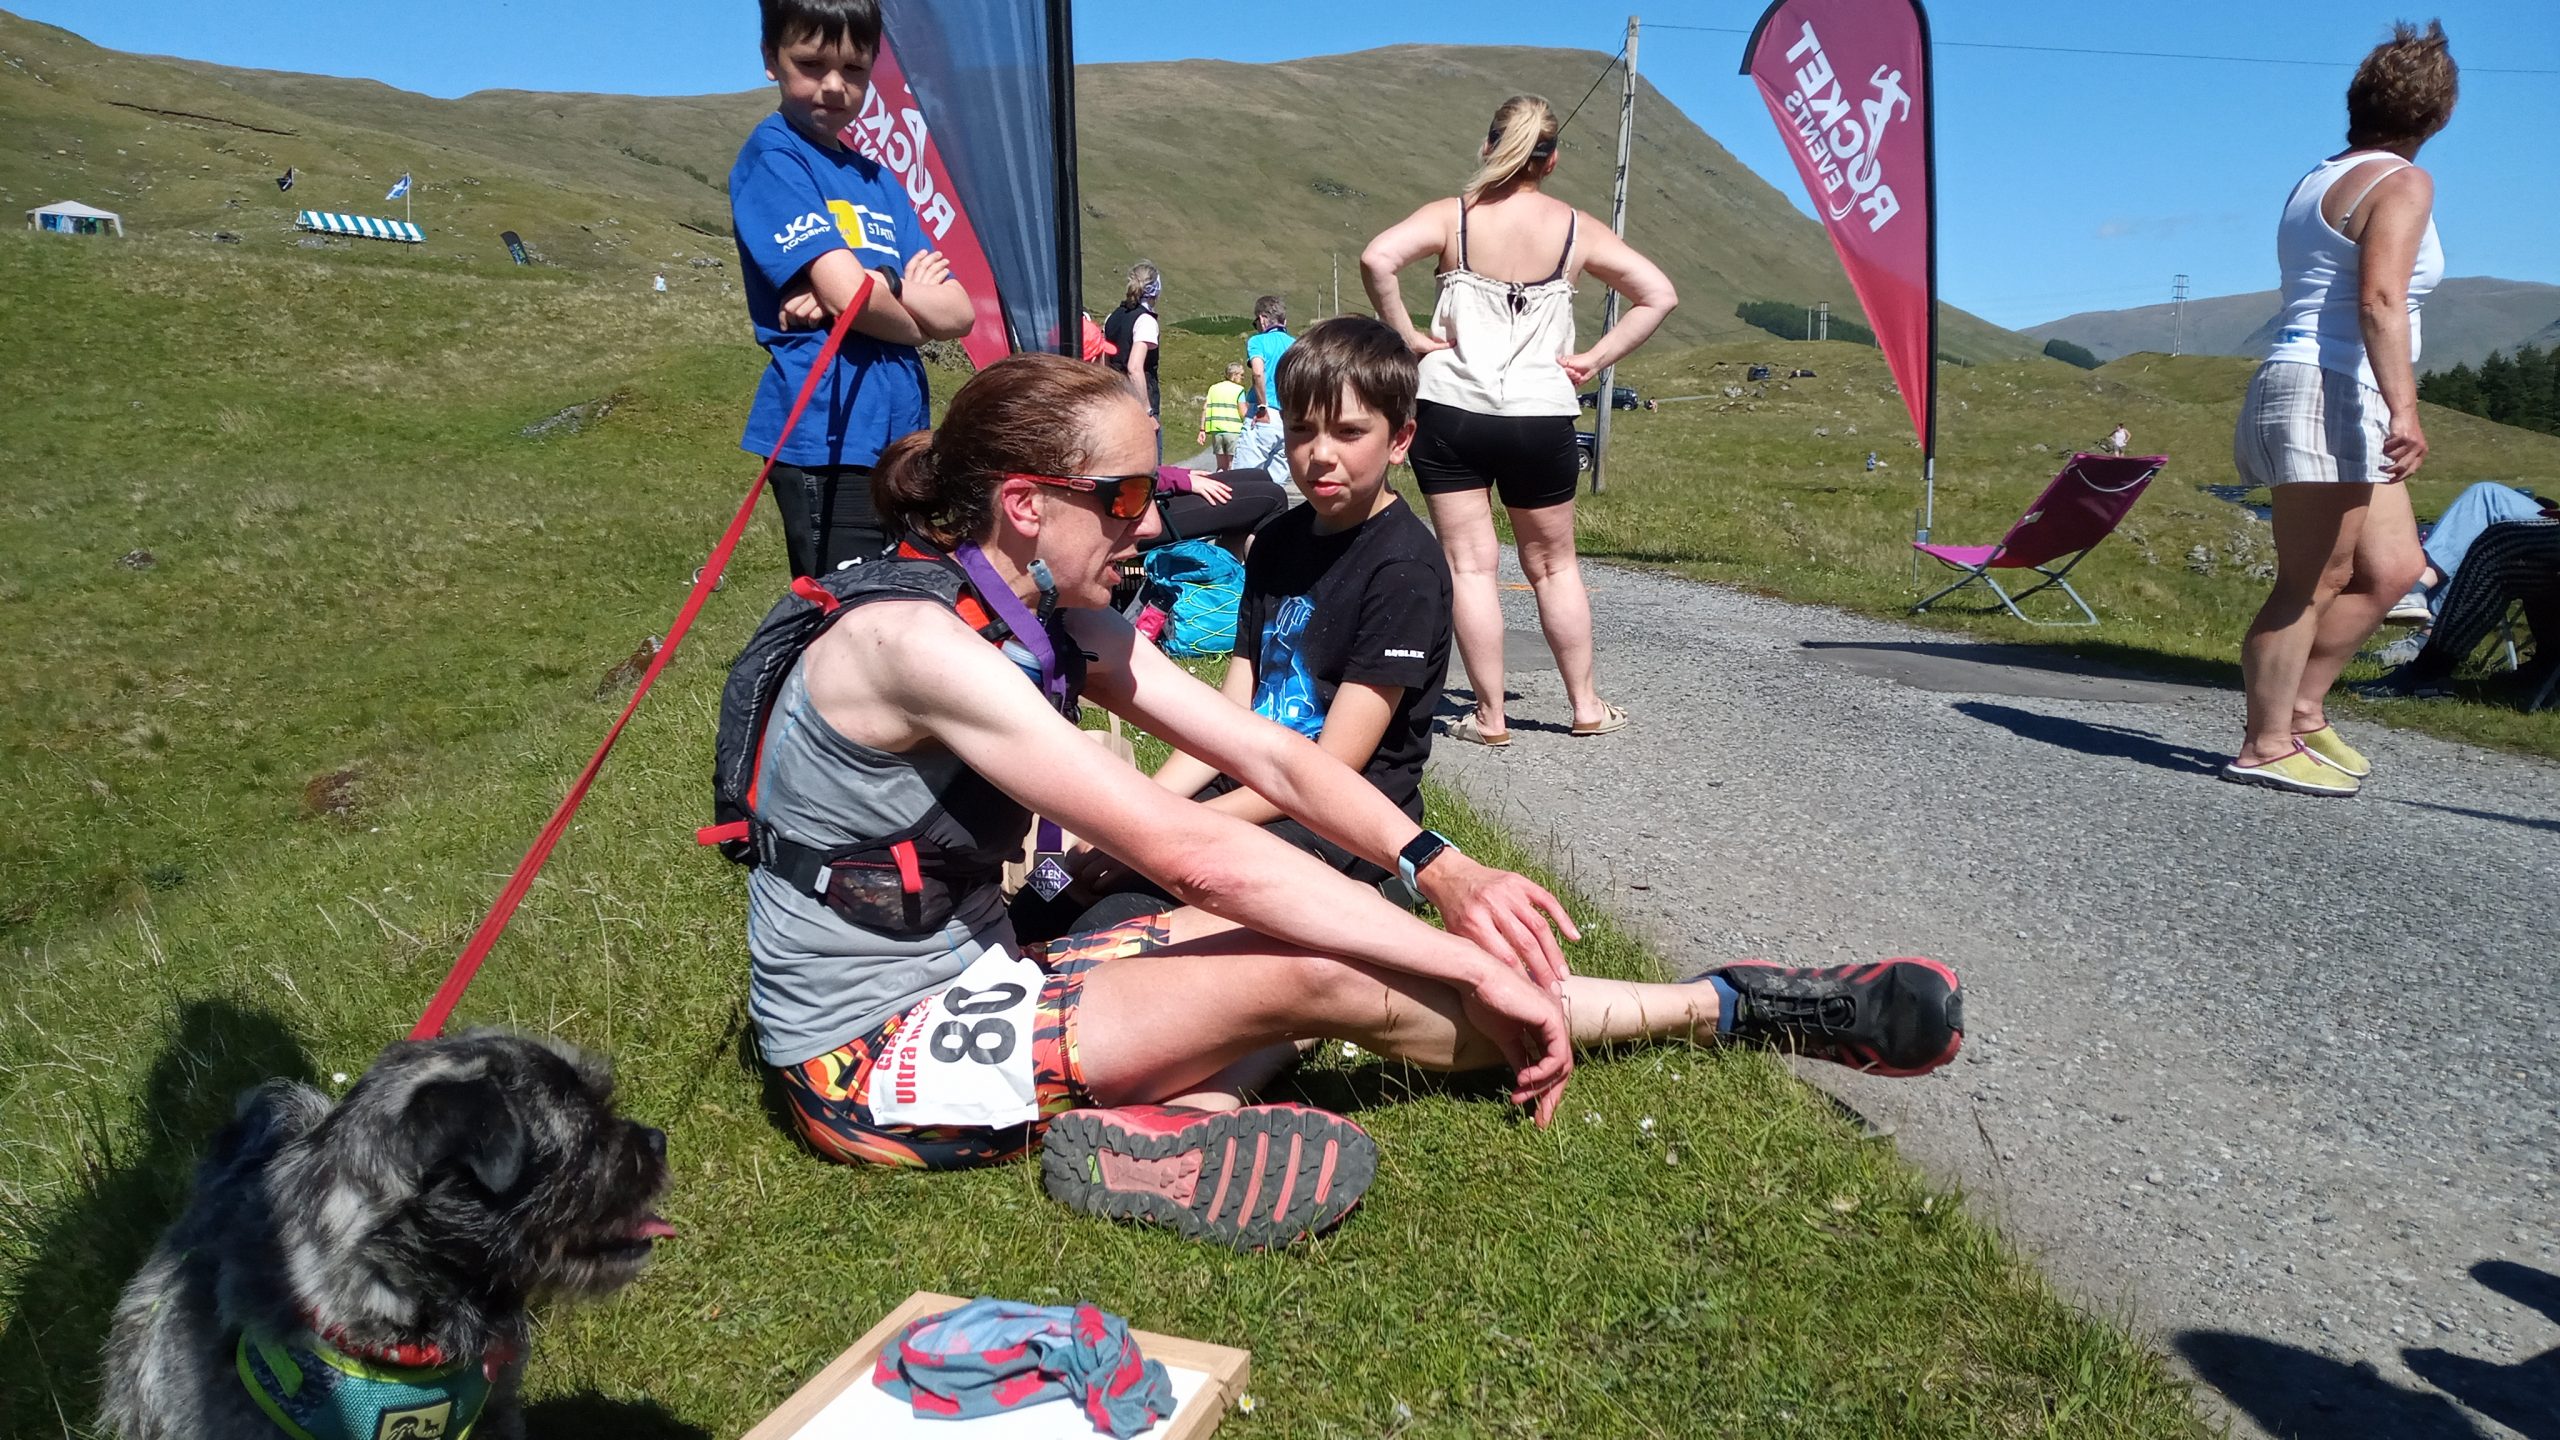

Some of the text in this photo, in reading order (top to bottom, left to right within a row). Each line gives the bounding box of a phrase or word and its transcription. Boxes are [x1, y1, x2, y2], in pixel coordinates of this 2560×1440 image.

[1035, 869, 1061, 880] GLEN
[1035, 880, 1061, 891] LYON
[929, 982, 1027, 1065] 80
[895, 1047, 917, 1104] Ultra
